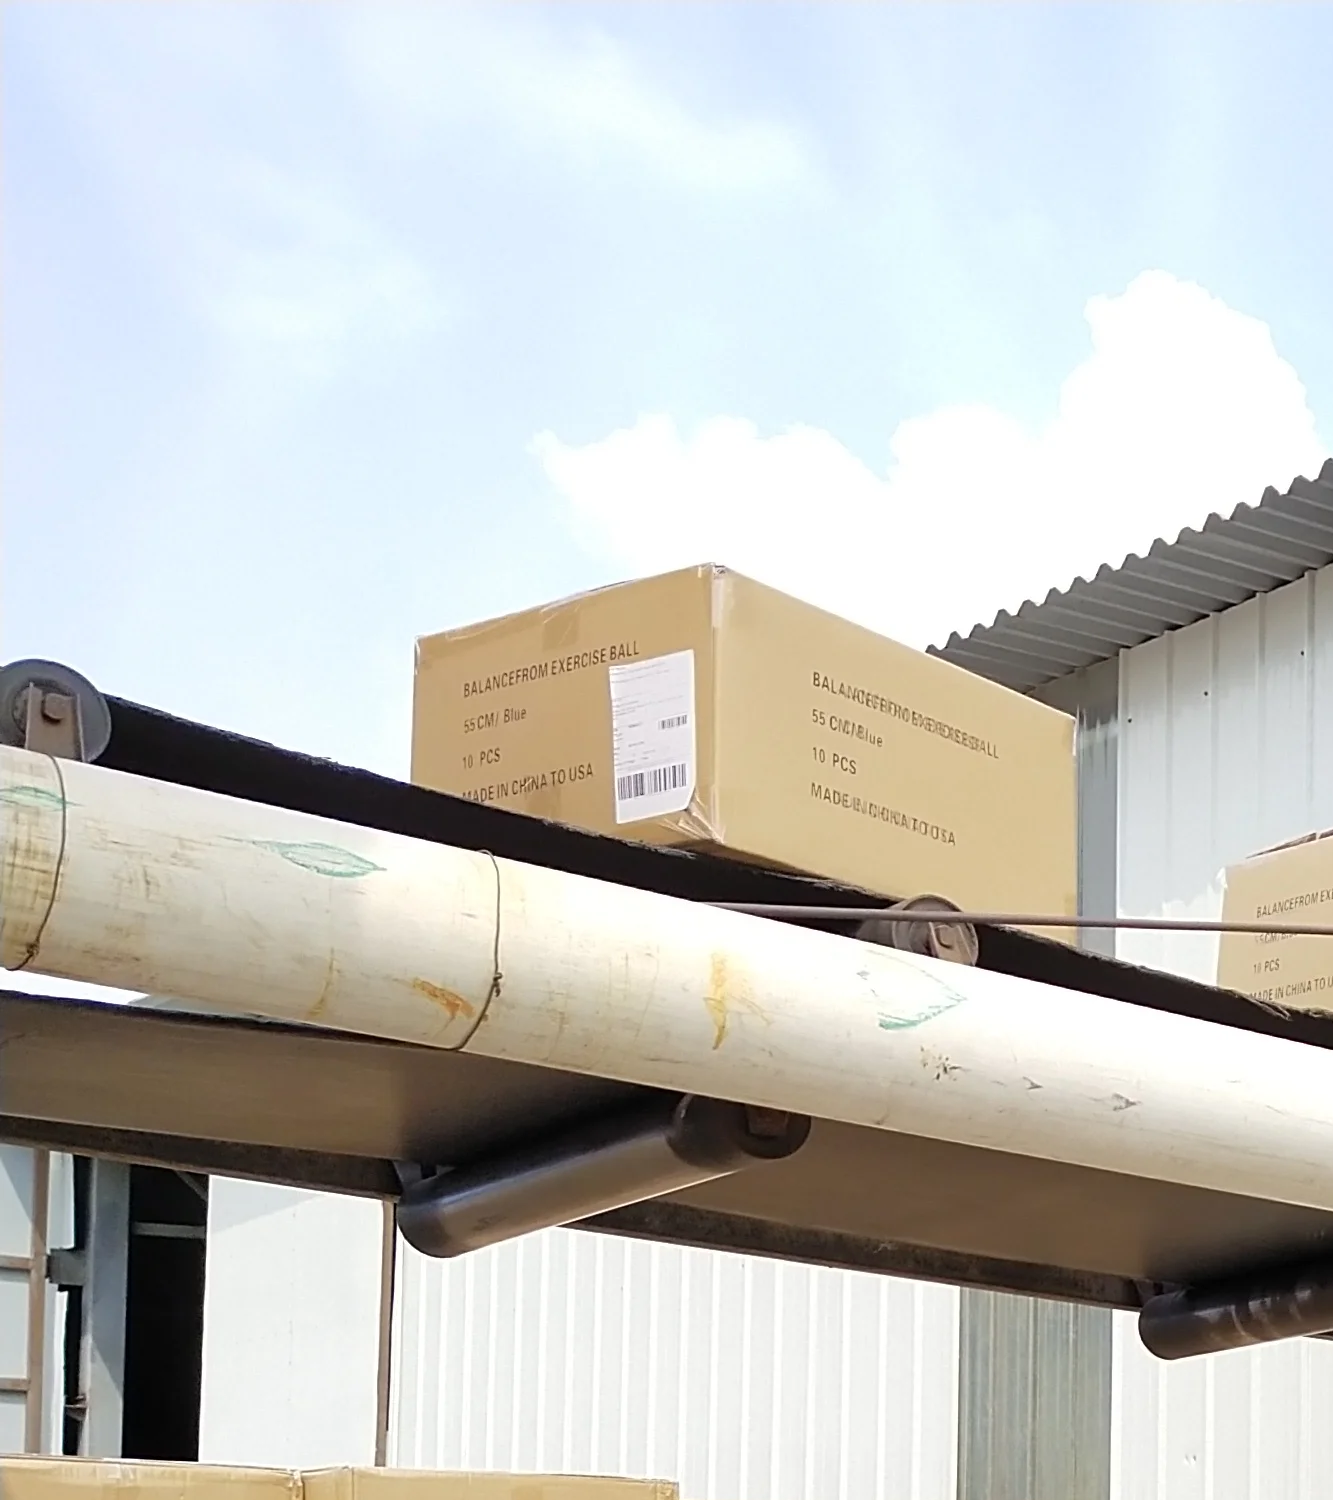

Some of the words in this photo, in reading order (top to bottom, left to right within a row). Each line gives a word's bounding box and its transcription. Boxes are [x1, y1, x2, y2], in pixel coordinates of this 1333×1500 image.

[464, 664, 548, 698] BALANCEFROM
[551, 648, 607, 676] EXERCISE
[610, 641, 640, 660] BALL
[504, 707, 527, 724] Blue
[812, 709, 826, 726] 55
[463, 754, 473, 769] 10
[480, 748, 500, 766] PCS
[813, 747, 825, 763] 10
[832, 753, 857, 775] PCS
[497, 784, 508, 799] IN
[512, 774, 547, 796] CHINA
[550, 770, 566, 786] TO
[570, 763, 594, 781] USA
[1257, 892, 1319, 918] BALANCEFROM
[1265, 958, 1280, 972] PCS
[1275, 987, 1284, 999] IN
[1286, 980, 1312, 996] CHINA
[1315, 978, 1326, 990] TO
